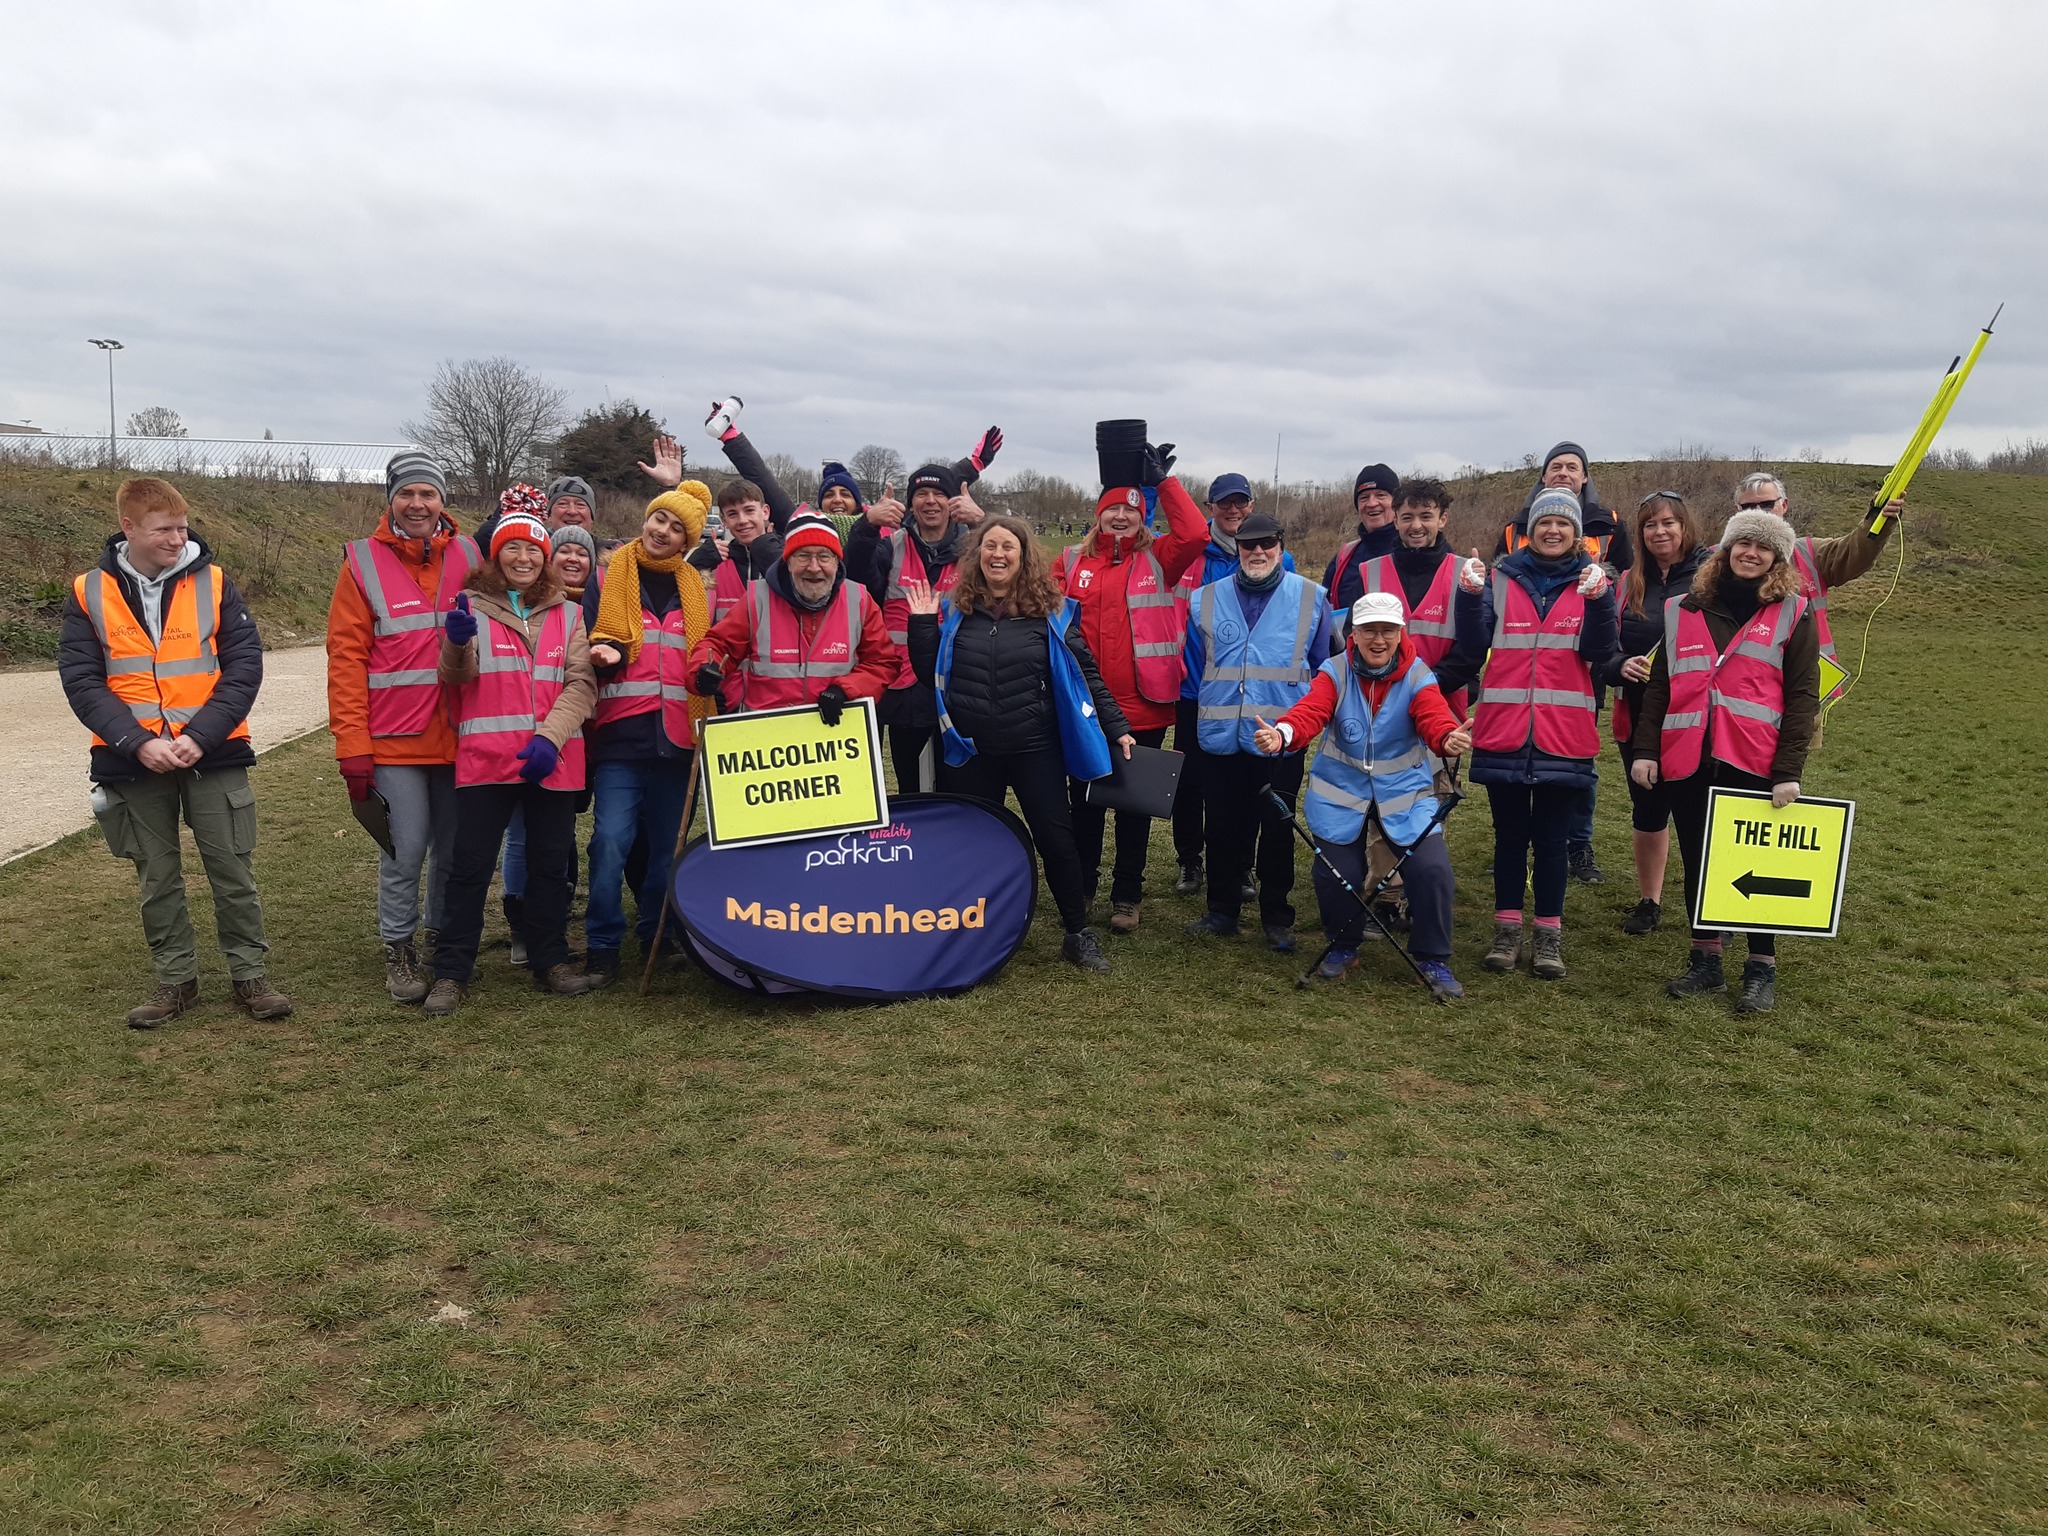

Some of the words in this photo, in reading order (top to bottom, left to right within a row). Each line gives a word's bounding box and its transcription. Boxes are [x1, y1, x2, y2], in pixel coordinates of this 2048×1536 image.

[392, 600, 421, 609] VOLUNTEER
[161, 632, 192, 641] WALKER
[822, 646, 848, 655] parkrun
[717, 737, 860, 775] MALCOLM'S
[744, 774, 841, 806] CORNER
[1733, 820, 1772, 846] THE
[1777, 823, 1821, 851] HILL
[804, 837, 913, 872] parkrun
[725, 896, 987, 934] Maidenhead
